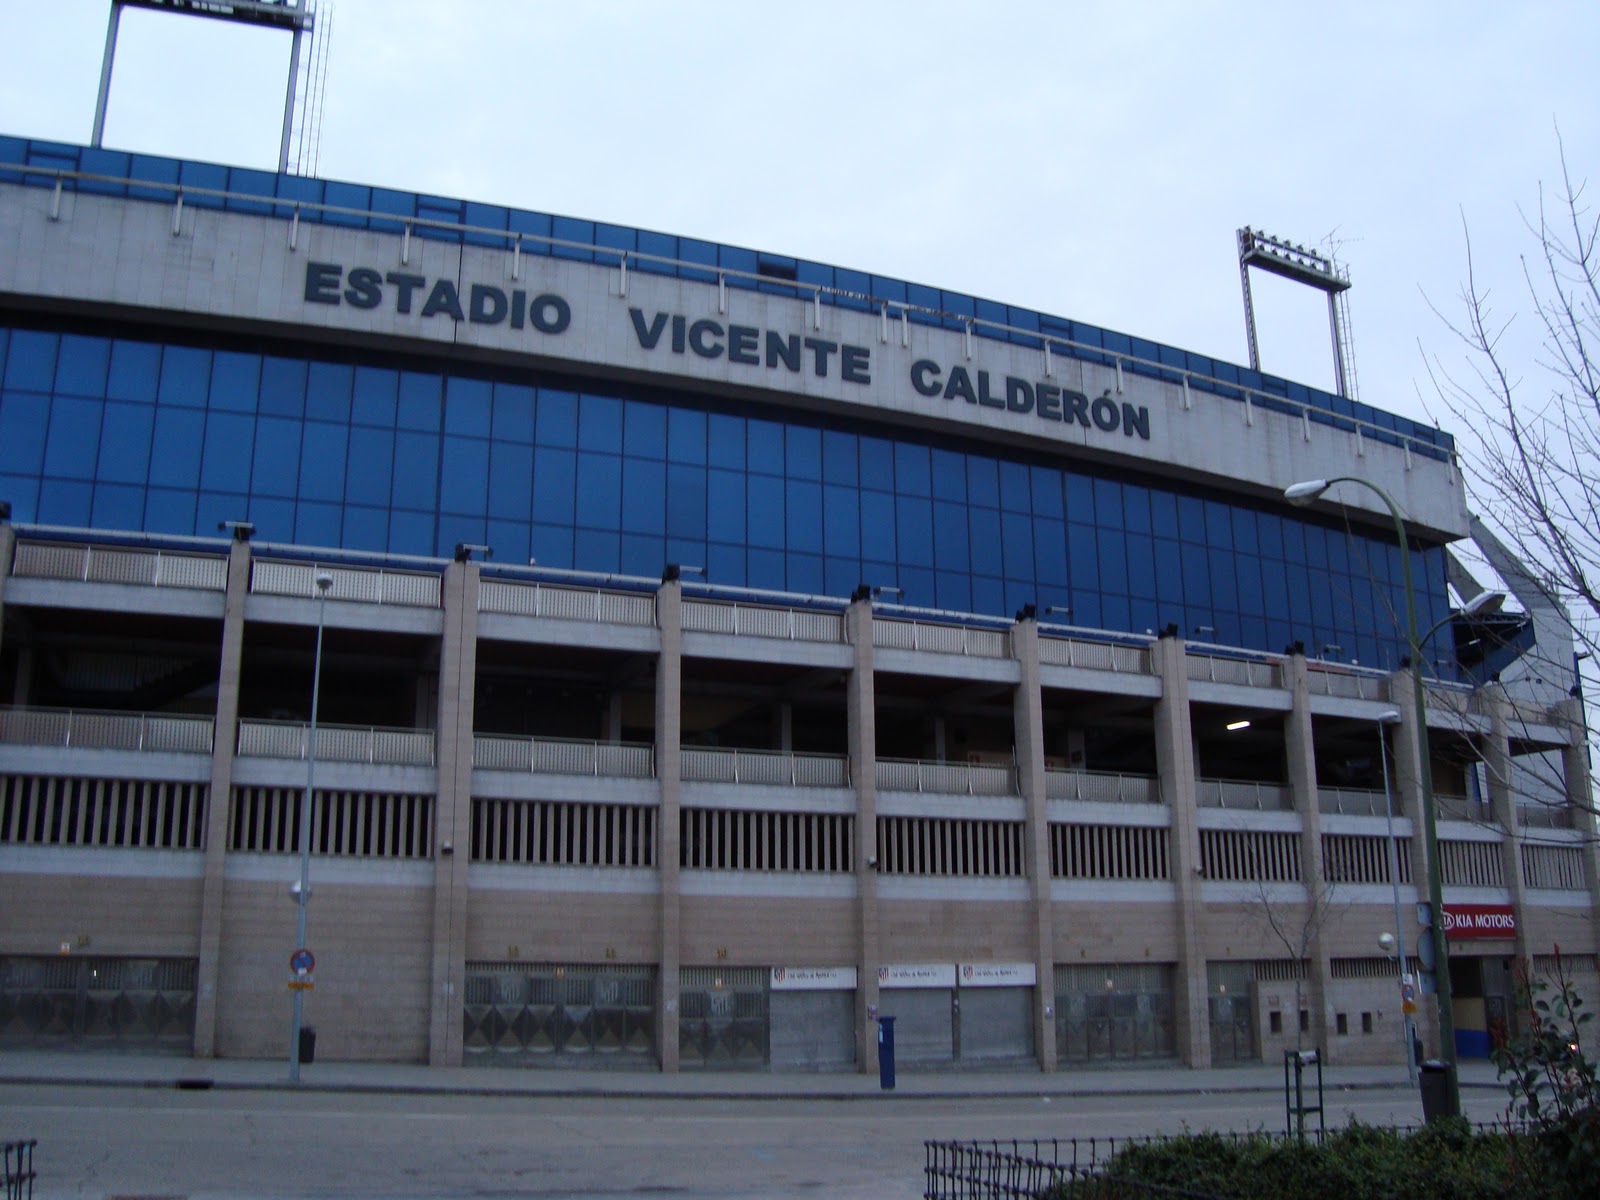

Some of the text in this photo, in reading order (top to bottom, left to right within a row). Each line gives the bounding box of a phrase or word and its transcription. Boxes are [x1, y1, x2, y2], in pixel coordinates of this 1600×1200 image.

[303, 261, 1150, 440] ESTADIO VICENTE CALDERÓN
[1455, 914, 1515, 928] KIA MOTORS
